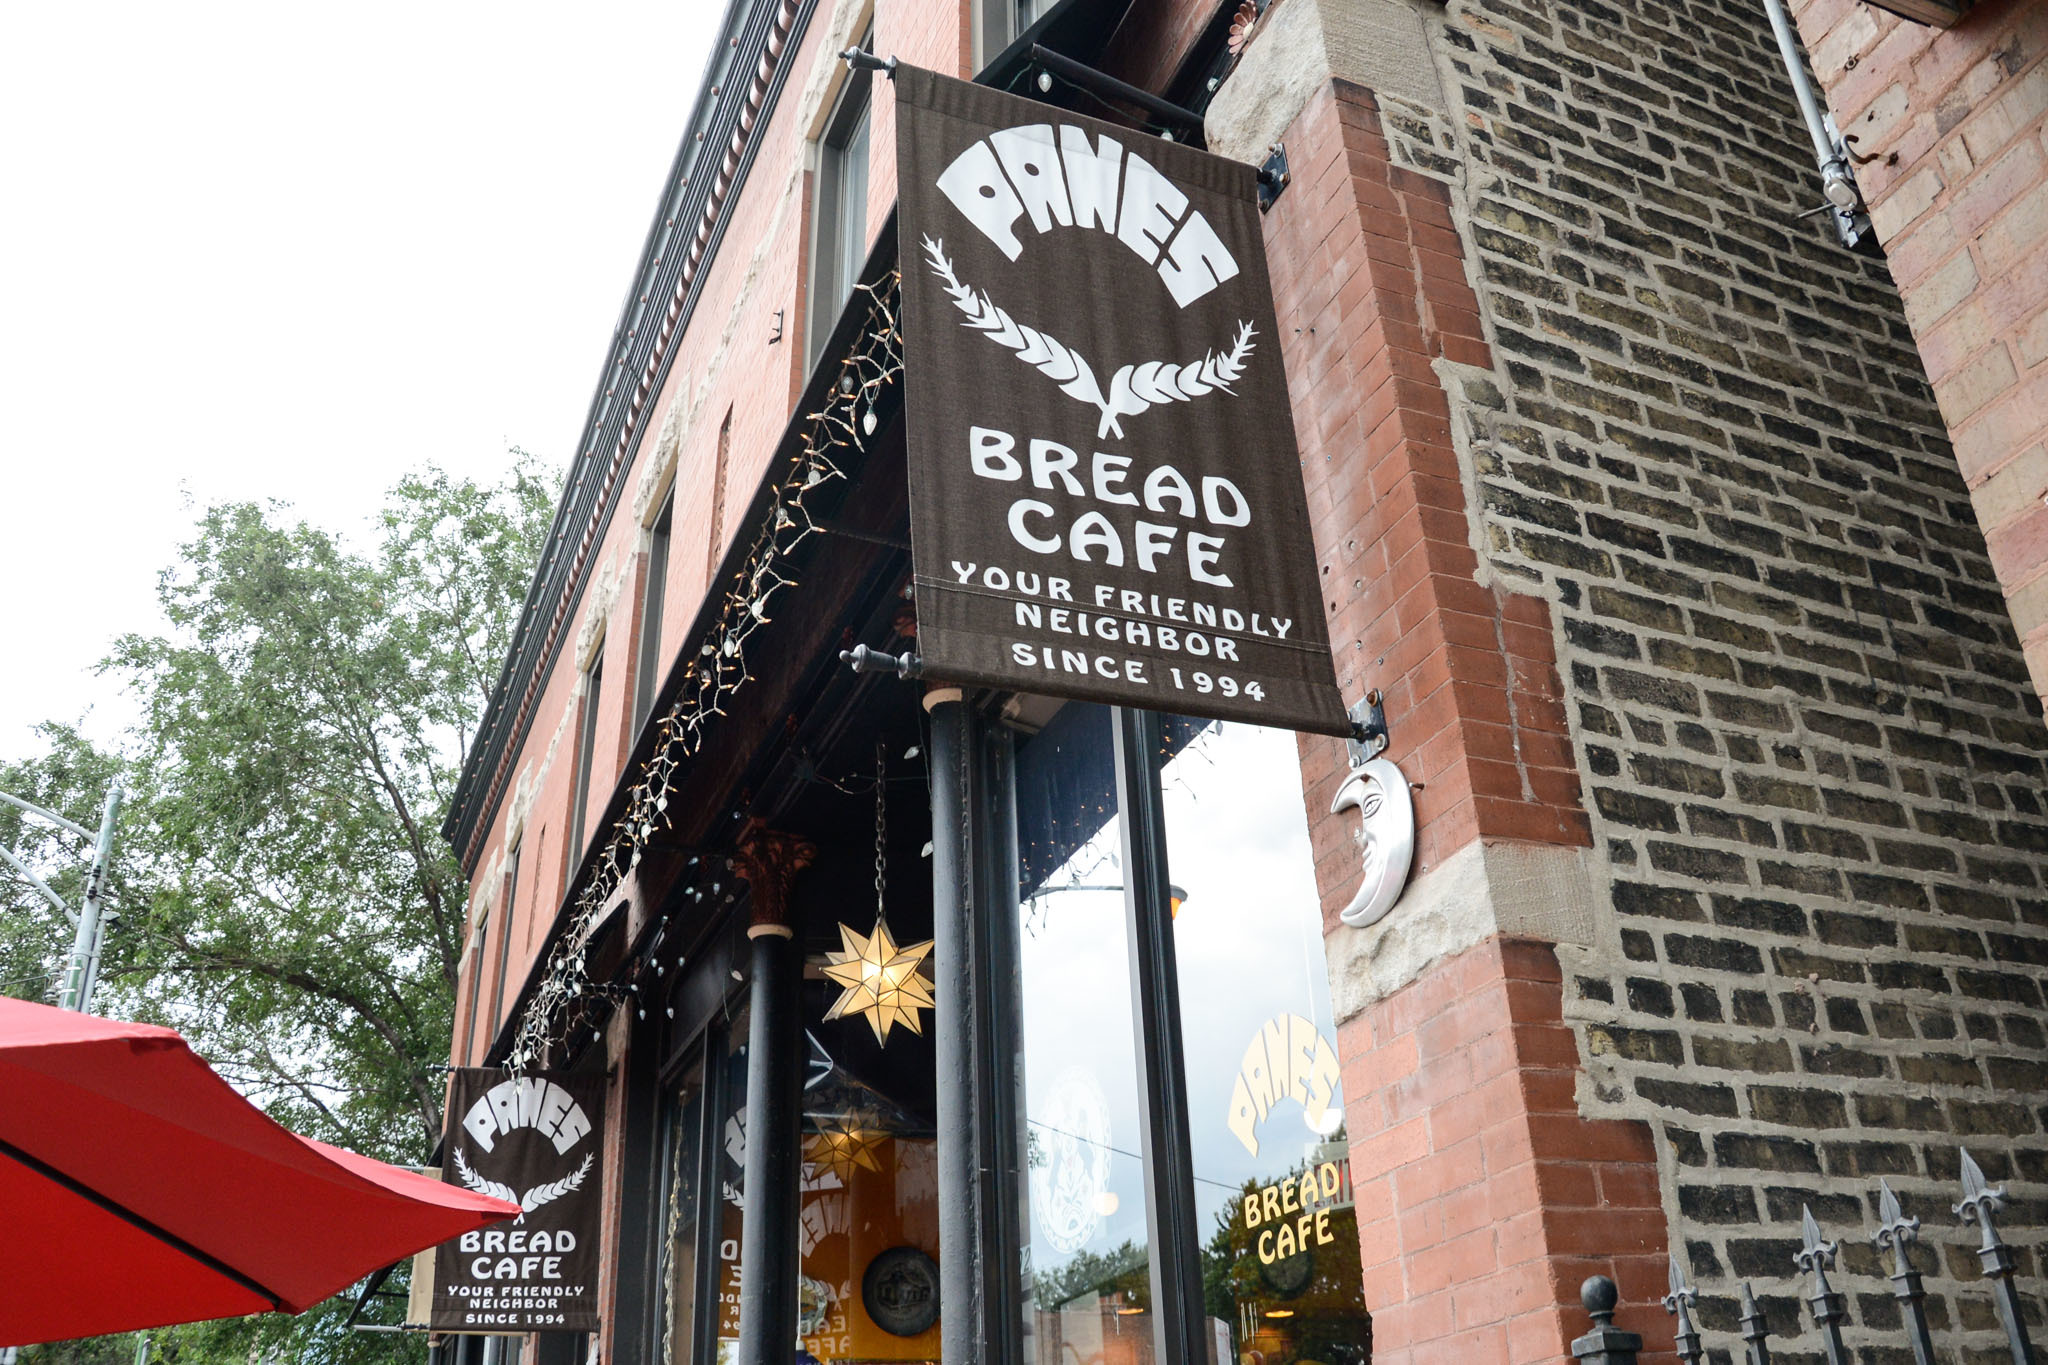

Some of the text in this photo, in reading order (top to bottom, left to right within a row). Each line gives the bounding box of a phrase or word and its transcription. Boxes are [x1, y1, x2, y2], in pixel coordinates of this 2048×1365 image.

[936, 123, 1240, 309] PANES
[969, 426, 1252, 528] BREAD
[1007, 499, 1234, 588] CAFE
[951, 560, 1293, 640] YOUR FRIENDLY
[1015, 602, 1240, 662] NEIGHBOR
[1011, 643, 1266, 702] SINCE 1994
[1227, 1011, 1341, 1159] PANES
[462, 1076, 592, 1156] PANES
[1244, 1161, 1340, 1230] BREAD
[460, 1230, 576, 1253] BREAD
[1257, 1207, 1335, 1265] CAFE
[448, 1285, 584, 1297] YOUR FRIENDLY
[471, 1256, 562, 1280] CAFE
[465, 1313, 565, 1324] SINCE 1994
[469, 1298, 558, 1309] NEIGHBOR
